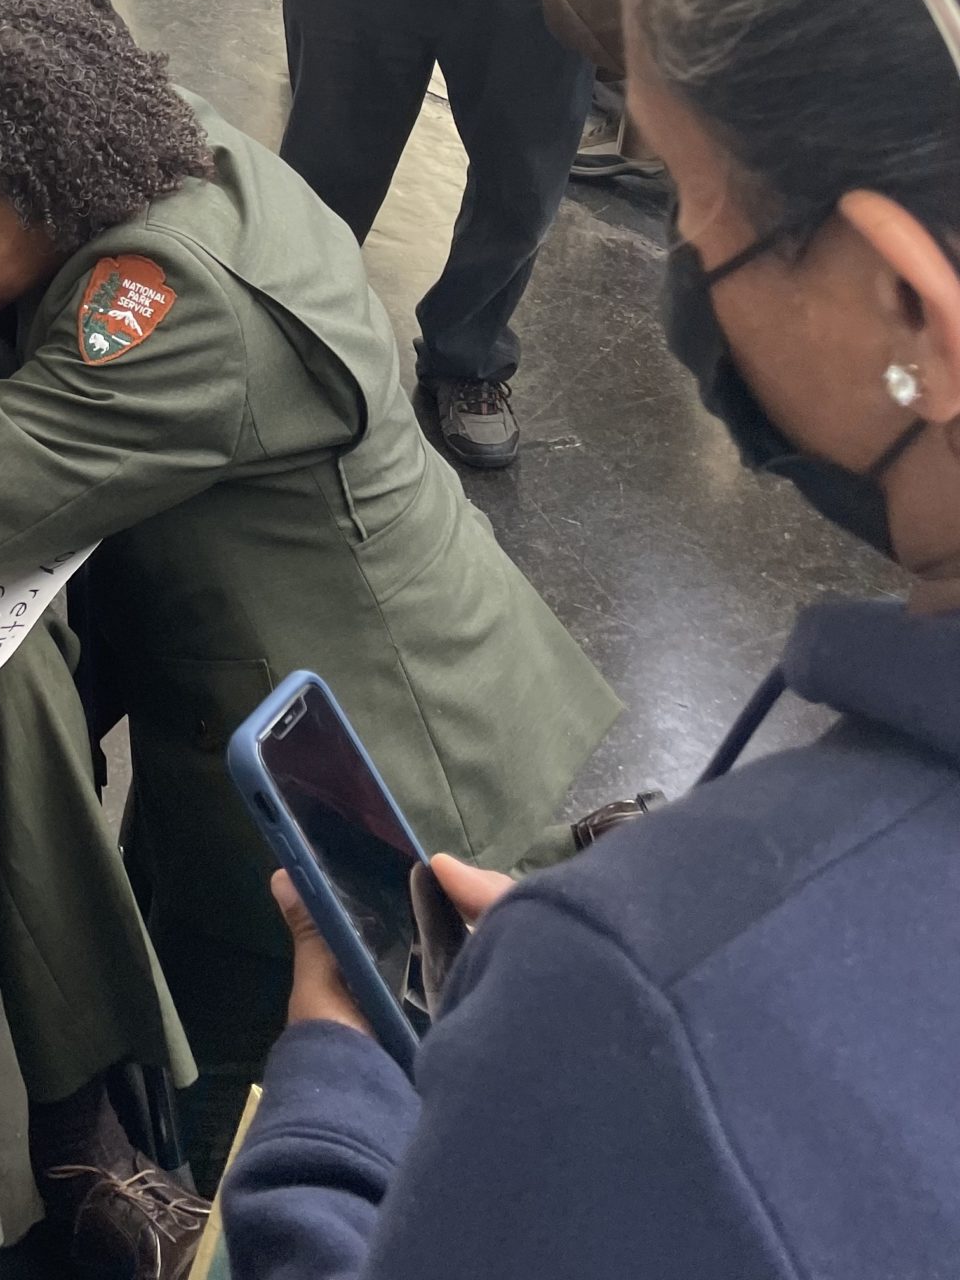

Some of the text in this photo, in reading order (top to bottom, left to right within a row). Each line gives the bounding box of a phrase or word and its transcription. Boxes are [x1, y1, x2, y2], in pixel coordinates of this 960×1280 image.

[122, 278, 165, 304] NATIONAL
[127, 290, 152, 307] PARK
[117, 296, 154, 318] SERVICE
